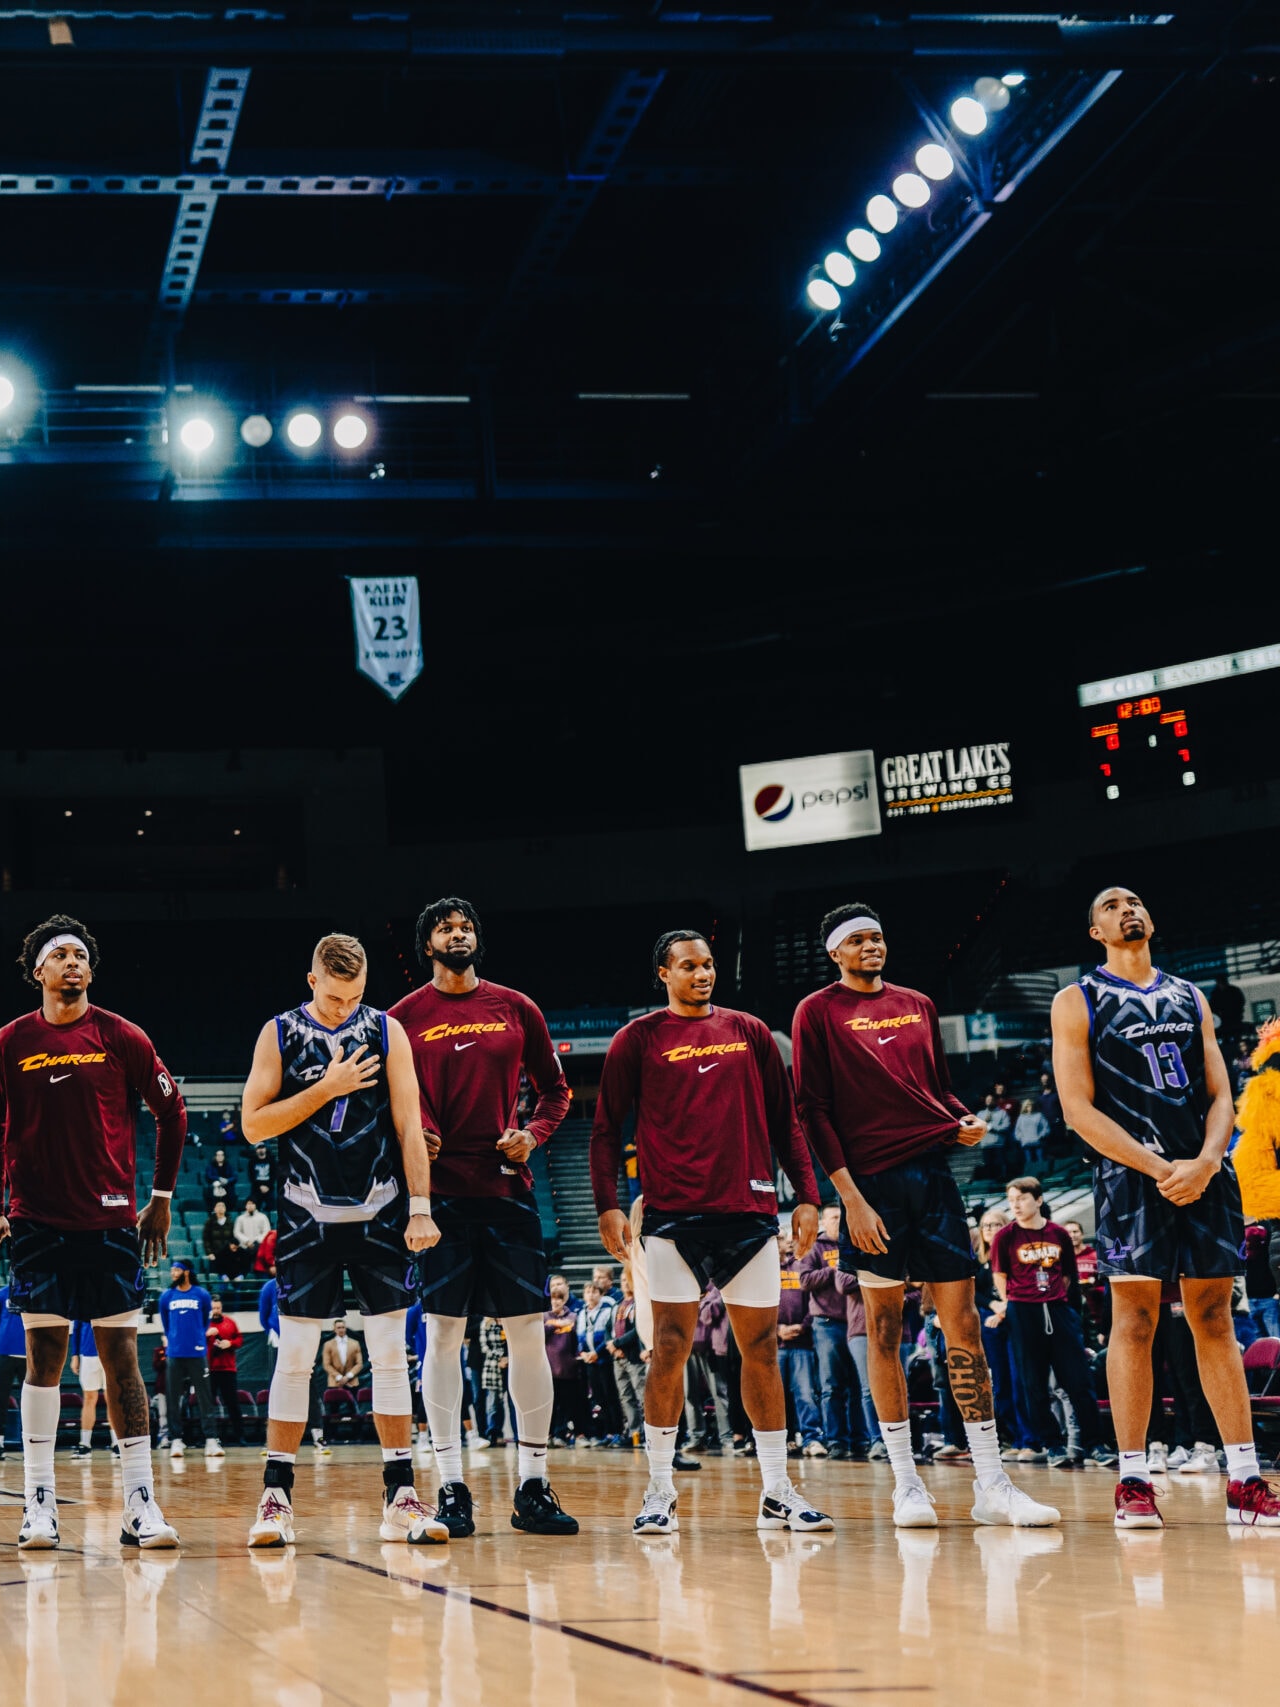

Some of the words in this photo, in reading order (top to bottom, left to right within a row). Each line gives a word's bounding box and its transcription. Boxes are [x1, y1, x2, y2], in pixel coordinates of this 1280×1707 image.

[373, 615, 408, 641] 23
[881, 750, 943, 788] GREAT
[946, 743, 1011, 782] LAKES
[802, 780, 869, 809] pepsi
[884, 778, 978, 802] BREWING
[418, 1022, 508, 1042] CHARGE
[844, 1014, 922, 1031] CHARGE
[1119, 1022, 1195, 1039] CHARGE
[18, 1053, 107, 1072] CHARGE
[661, 1041, 748, 1062] CHARGE
[1142, 1042, 1190, 1090] 13
